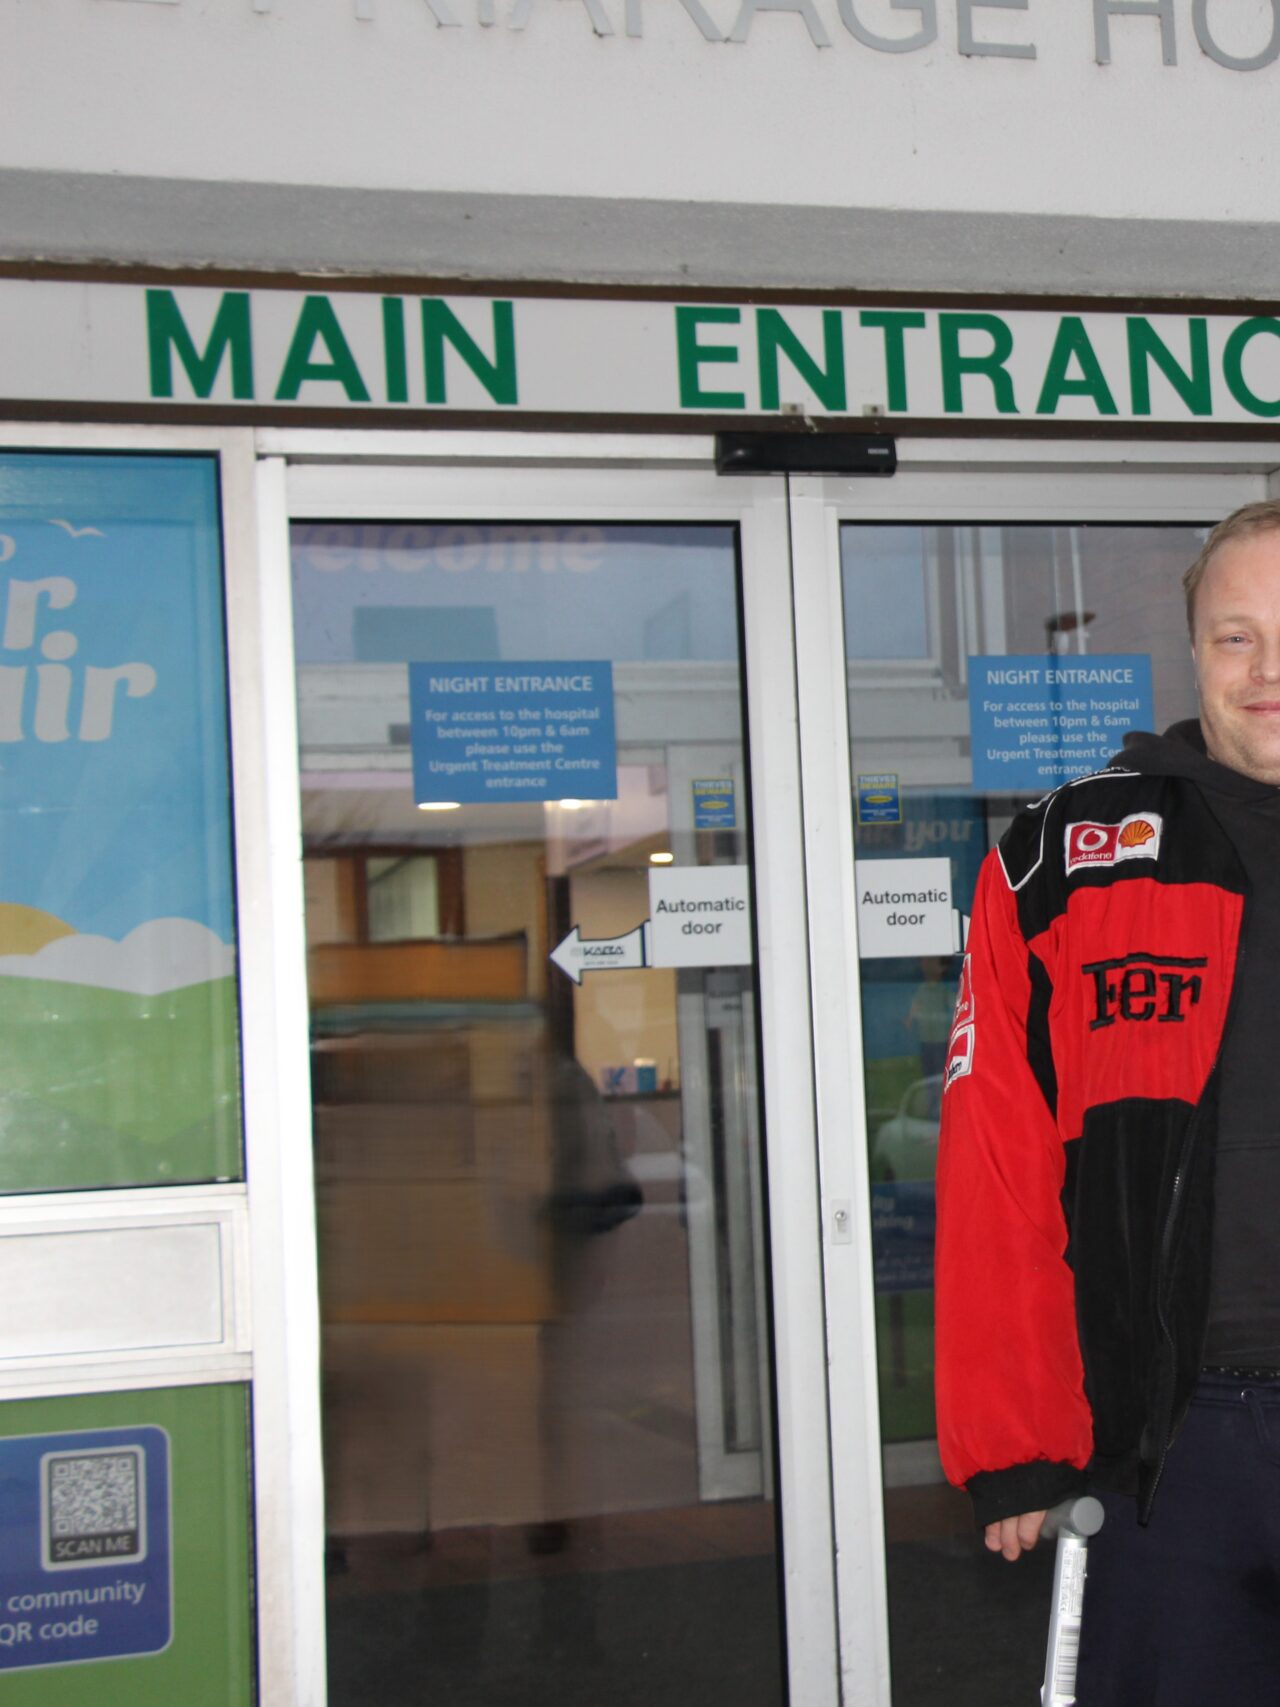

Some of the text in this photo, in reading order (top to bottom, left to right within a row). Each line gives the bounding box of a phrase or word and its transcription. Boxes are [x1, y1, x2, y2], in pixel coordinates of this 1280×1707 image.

[145, 288, 519, 405] MAIN
[430, 676, 593, 692] NIGHT ENTRANCE
[987, 669, 1134, 685] NIGHT ENTRANCE
[983, 698, 1139, 713] For access to the hospital
[425, 707, 600, 722] For access to the hospital
[994, 715, 1131, 729] between 10pm & 6am
[437, 724, 589, 740] between 10pm & 6am
[1019, 731, 1108, 746] please use the
[465, 742, 564, 757] please use the
[987, 749, 1030, 762] Urgent
[1033, 748, 1096, 759] Treatment
[429, 758, 600, 775] Urgent Treatment Centre
[1037, 764, 1092, 775] entrance
[485, 776, 547, 788] entrance
[862, 888, 948, 905] Automatic
[656, 897, 745, 914] Automatic
[886, 912, 925, 926] door
[681, 921, 722, 935] door
[1081, 952, 1208, 1031] Fer
[56, 1535, 132, 1558] SCAN ME
[7, 1580, 146, 1612] community
[0, 1615, 99, 1645] QR code
